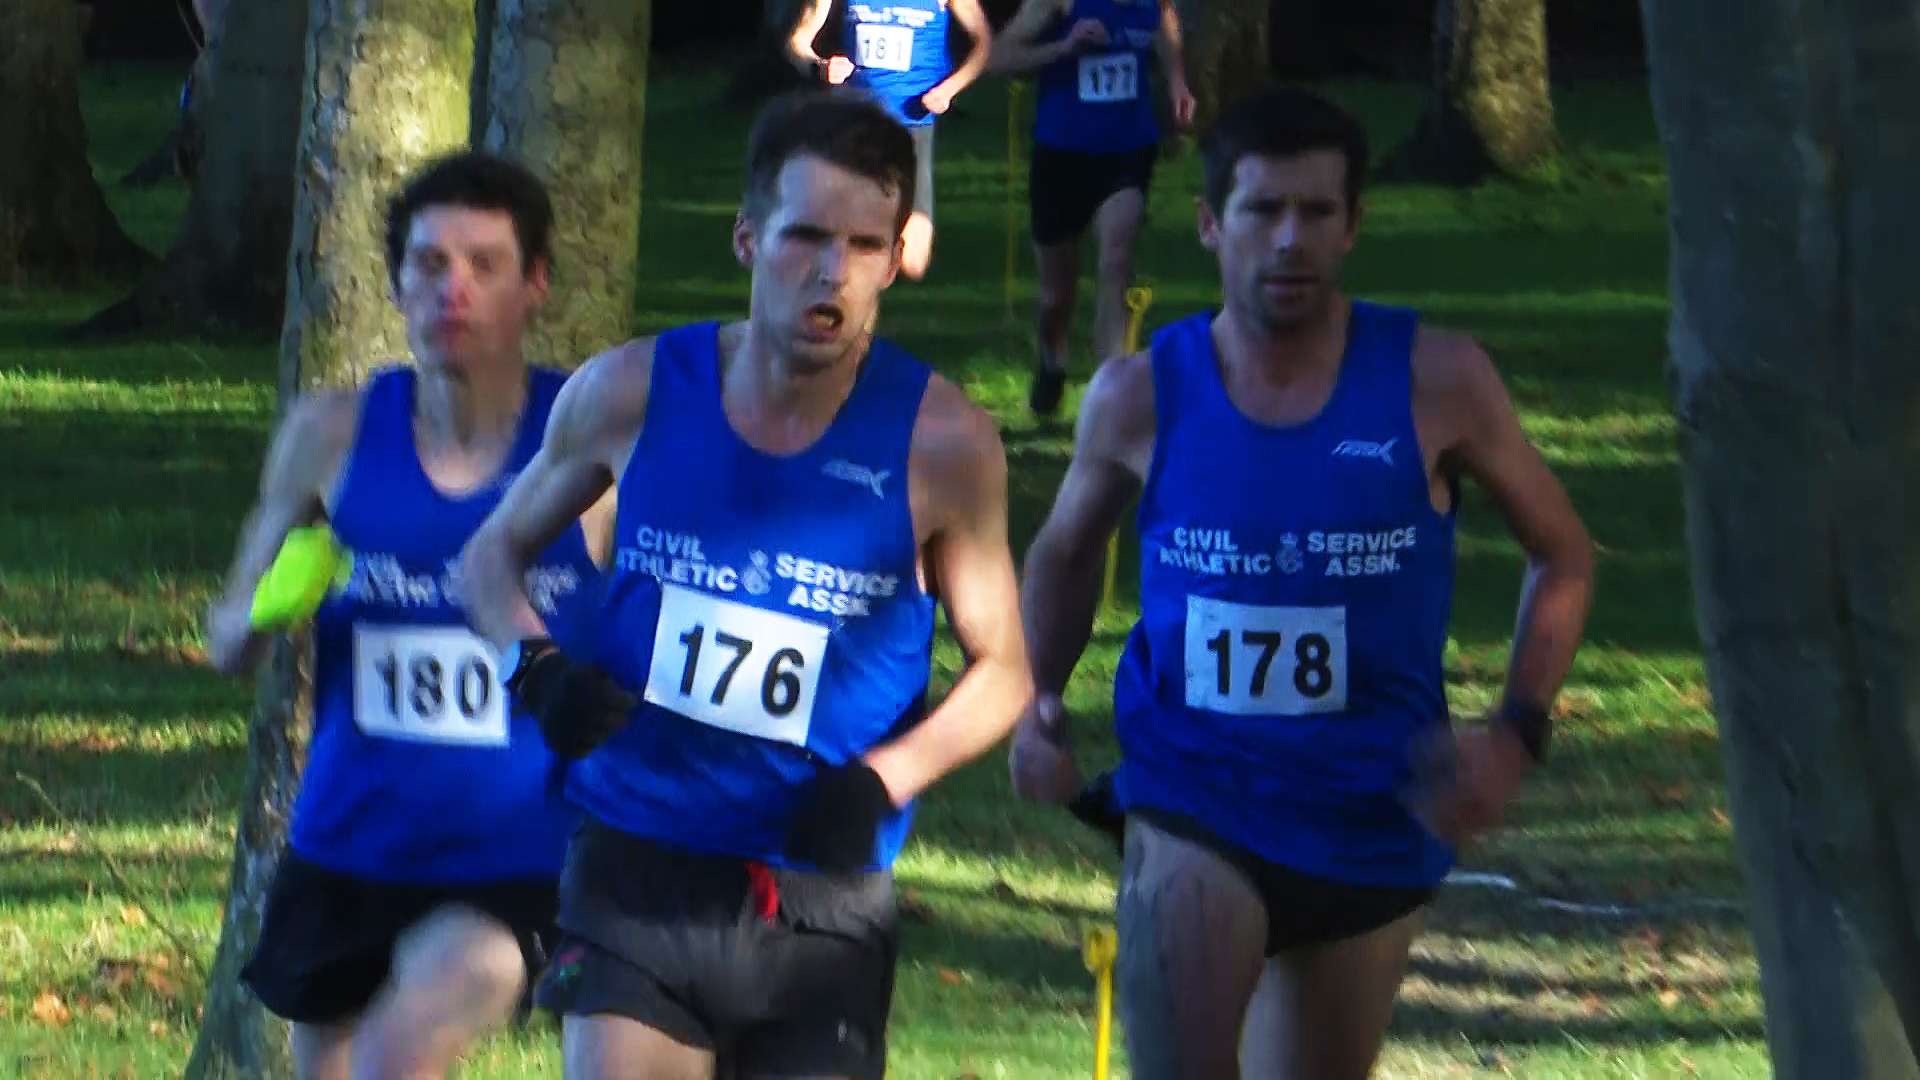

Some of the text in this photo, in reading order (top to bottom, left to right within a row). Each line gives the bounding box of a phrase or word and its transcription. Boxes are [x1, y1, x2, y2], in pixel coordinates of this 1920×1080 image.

[862, 37, 903, 62] 181
[1089, 63, 1133, 96] 177
[637, 525, 899, 597] CIVIL SERVICE
[1173, 525, 1417, 554] CIVIL SERVICE
[375, 652, 495, 722] 180
[679, 622, 805, 717] 176
[1207, 629, 1332, 699] 178
